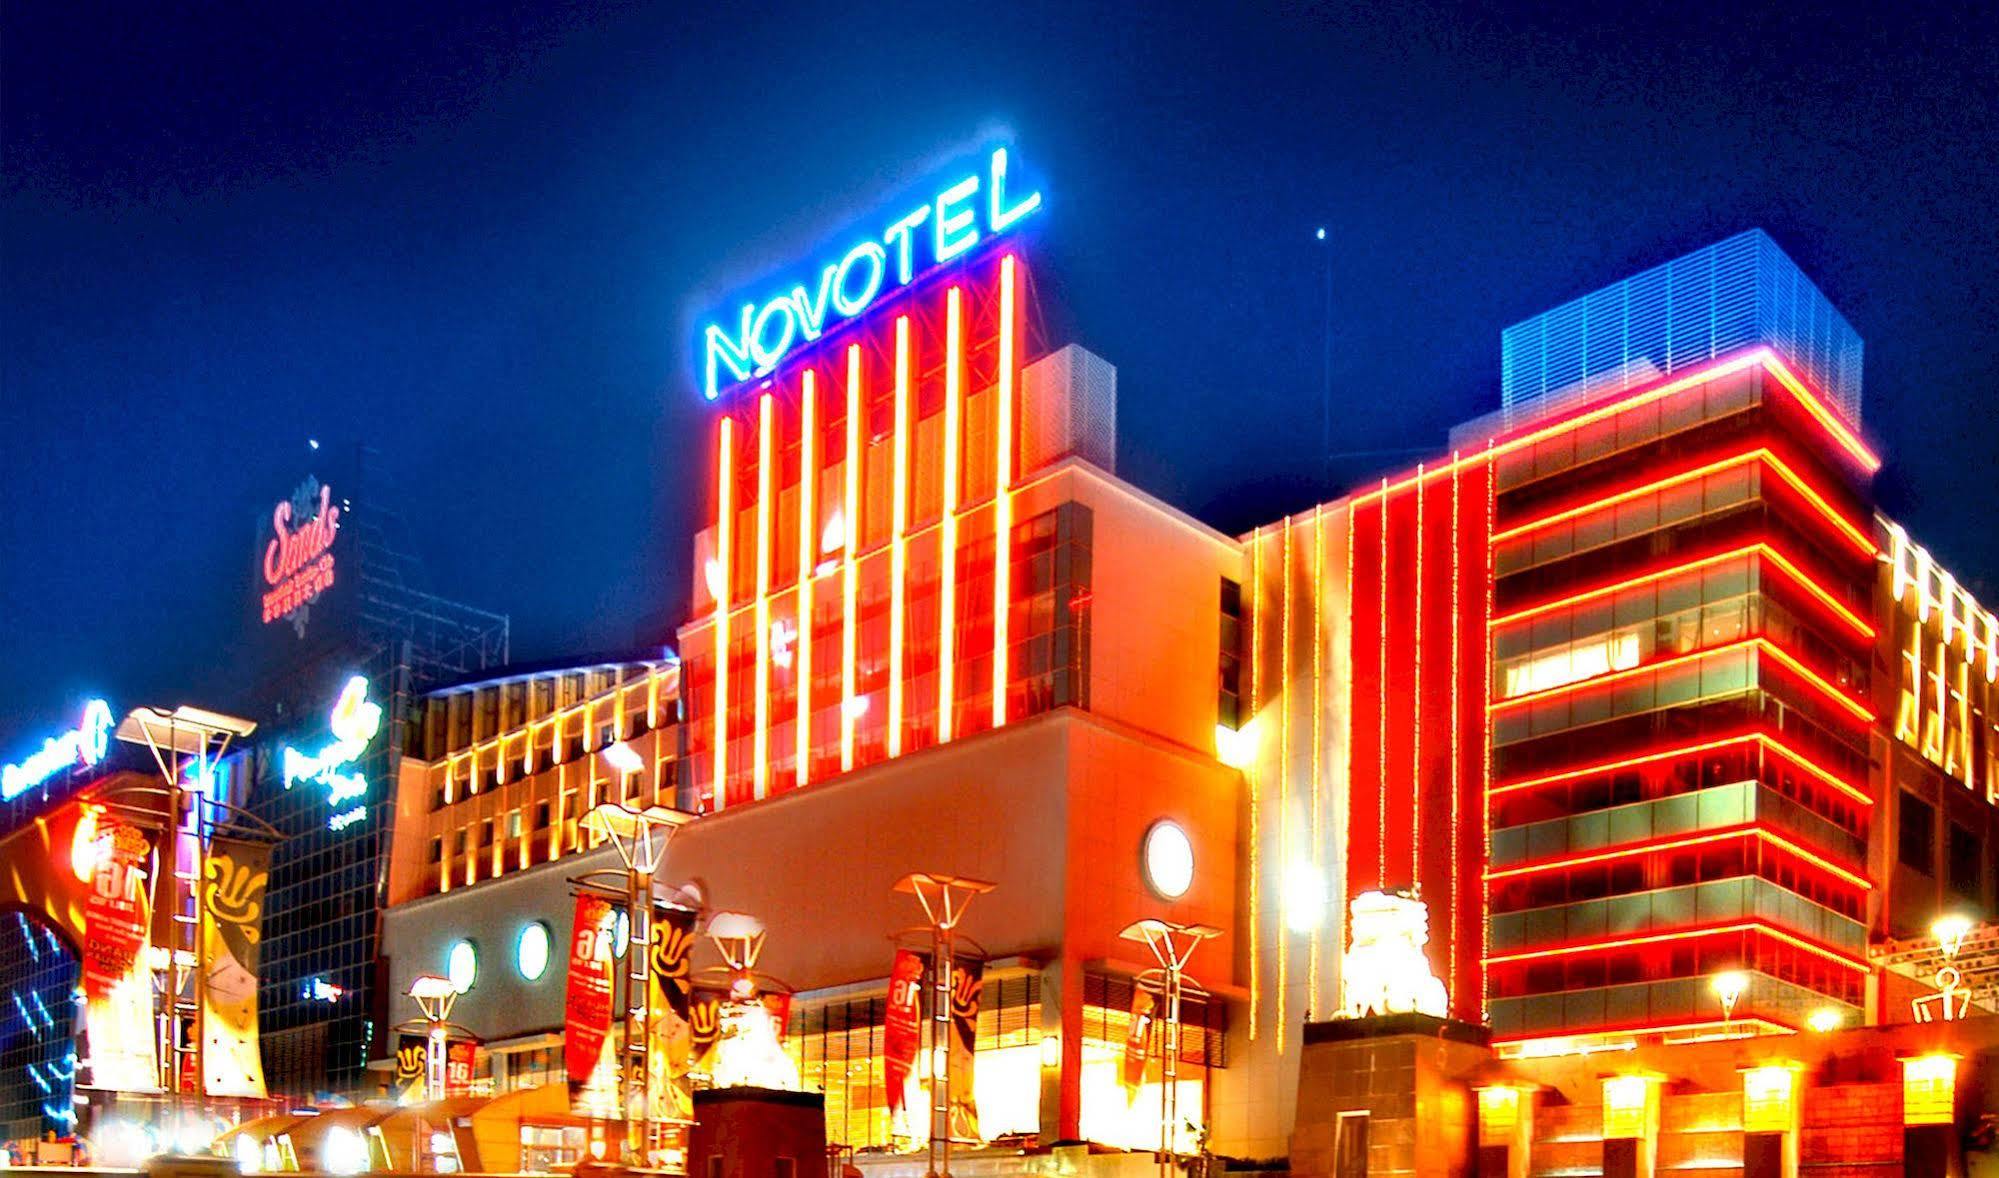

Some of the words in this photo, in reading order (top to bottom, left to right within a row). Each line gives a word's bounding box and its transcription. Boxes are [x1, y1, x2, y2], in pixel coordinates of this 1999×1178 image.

[704, 147, 1042, 401] NOVOTEL
[264, 485, 340, 585] Sands
[447, 1061, 469, 1081] 16
